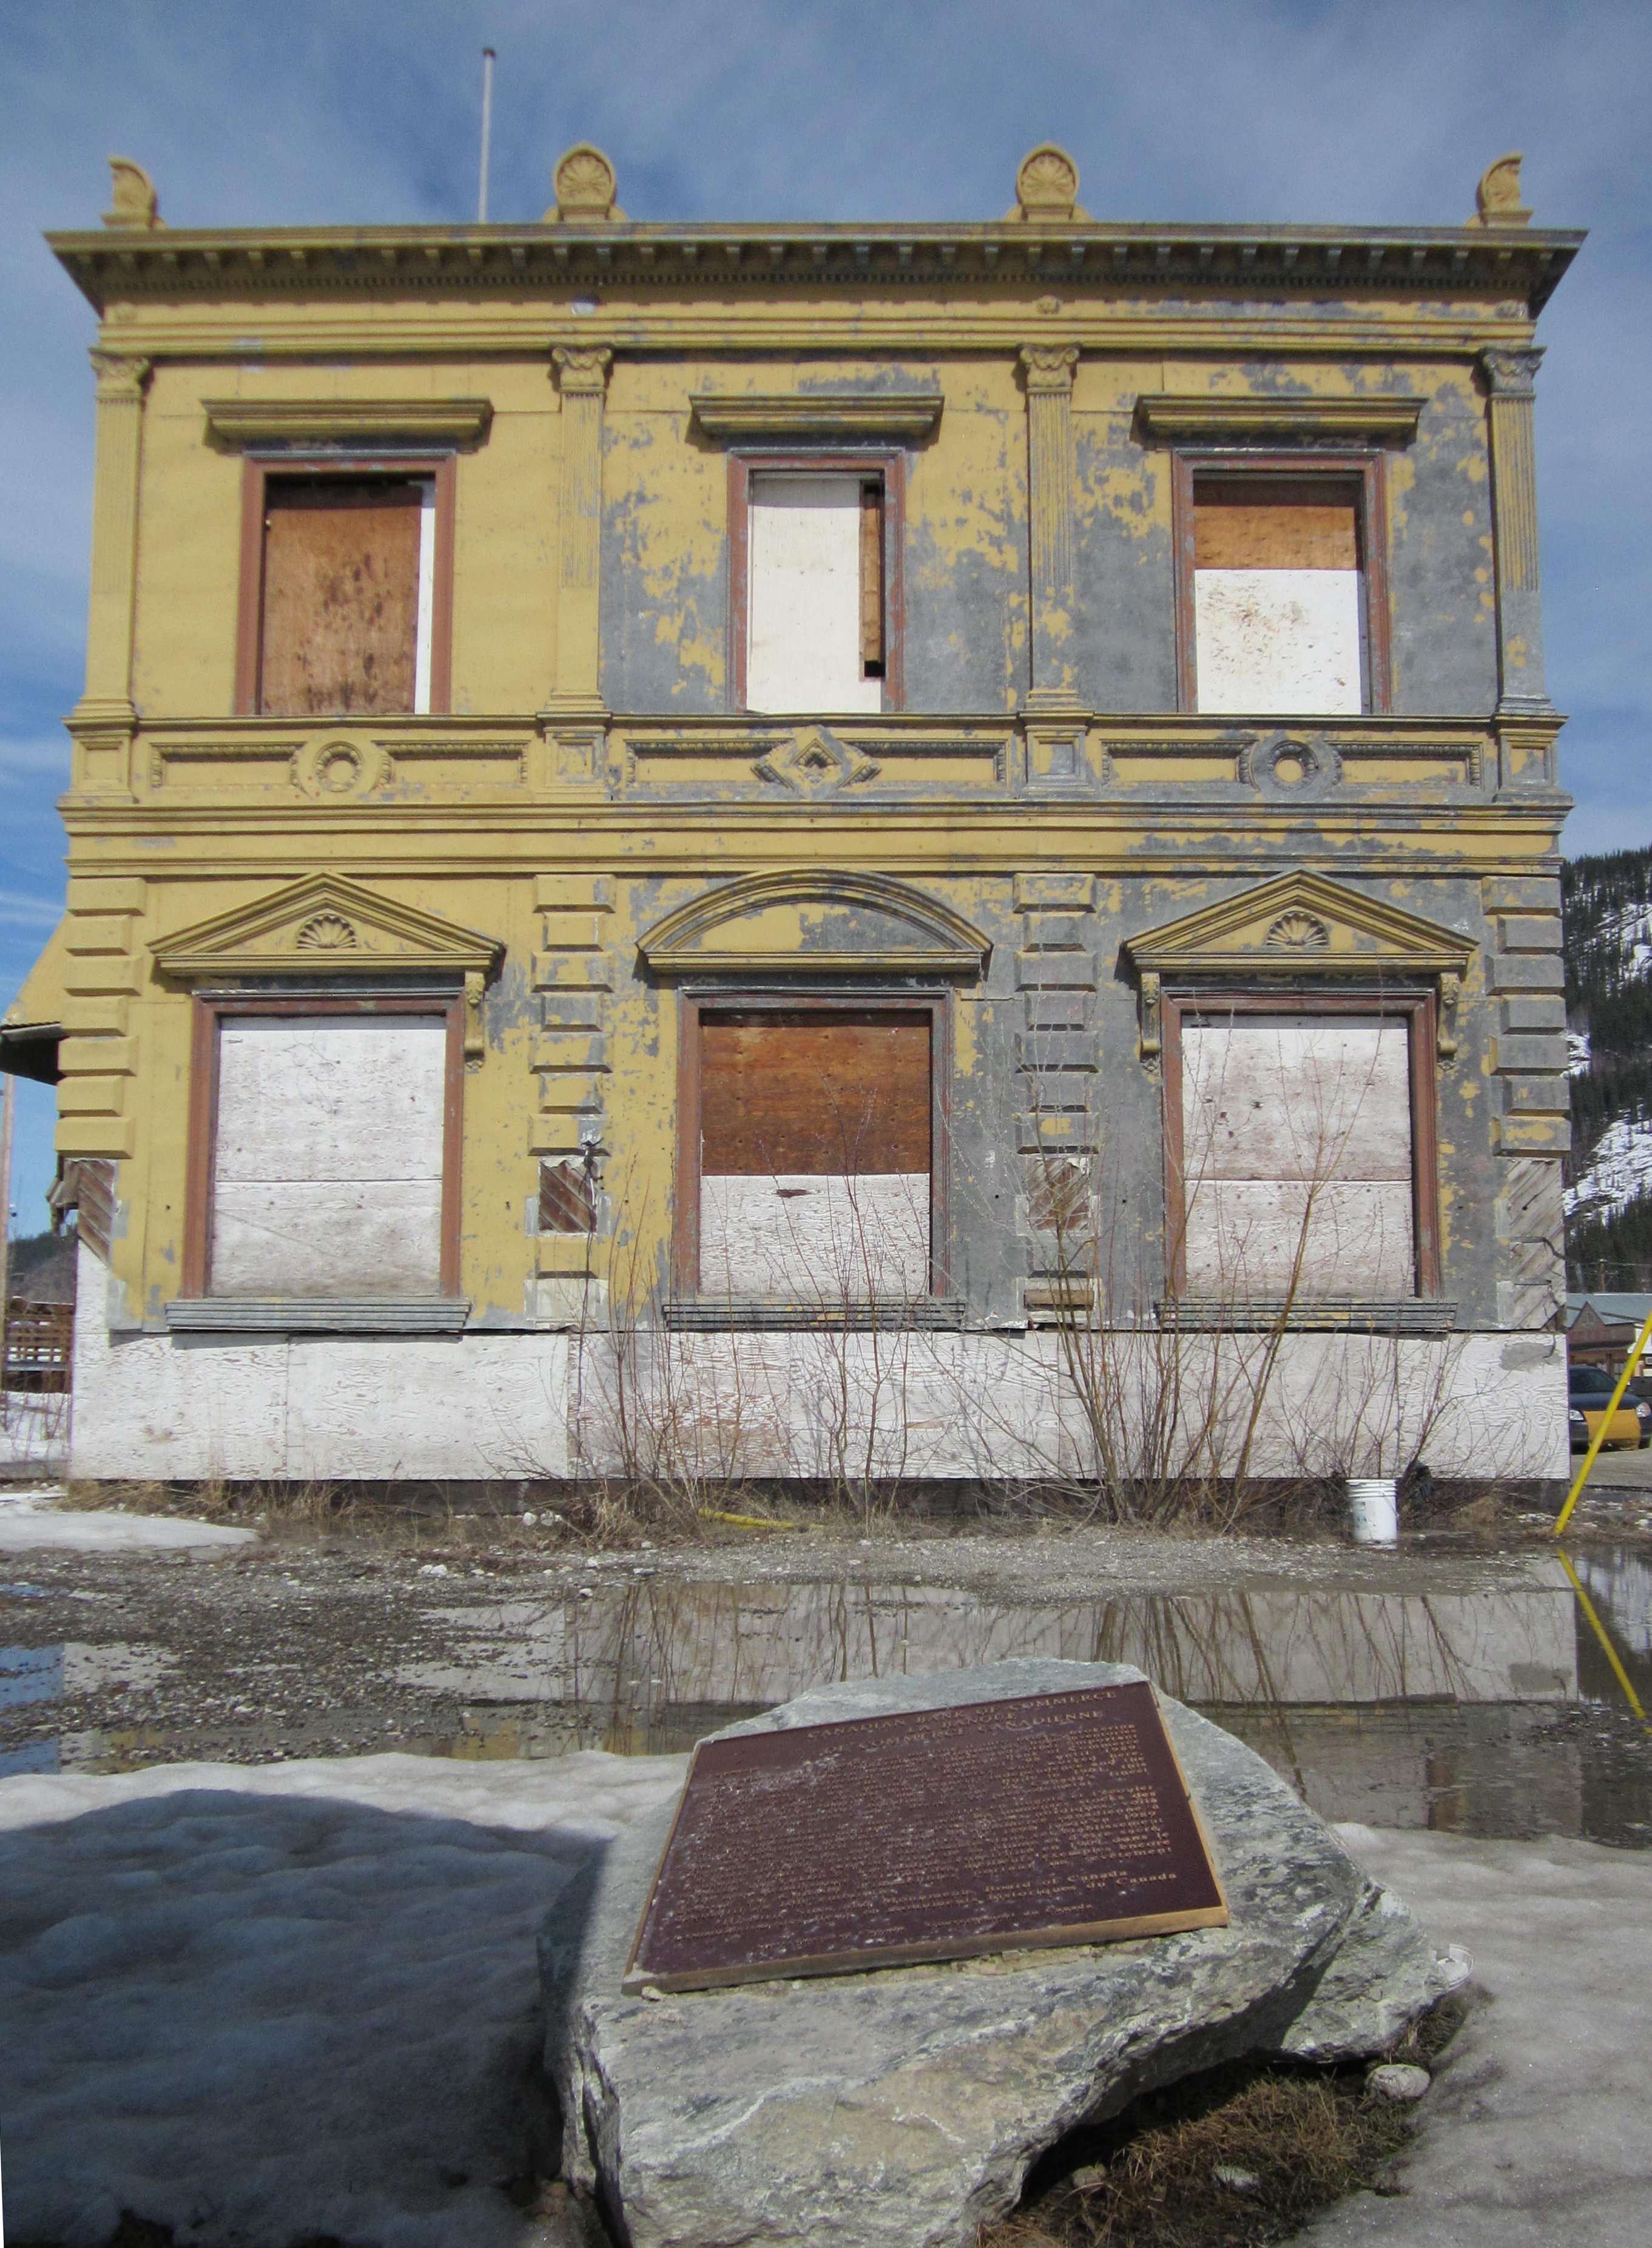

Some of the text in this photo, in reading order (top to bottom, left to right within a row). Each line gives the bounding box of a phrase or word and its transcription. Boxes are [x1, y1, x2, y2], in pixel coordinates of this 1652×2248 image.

[806, 1718, 906, 1739] CANADIAN
[917, 1710, 965, 1724] BANK
[1008, 1690, 1117, 1712] COMMERCE
[858, 1727, 965, 1749] COMMERCE
[979, 1709, 1103, 1733] CANADIENNE
[1067, 1869, 1128, 1883] Canada
[1116, 1871, 1178, 1886] Canada
